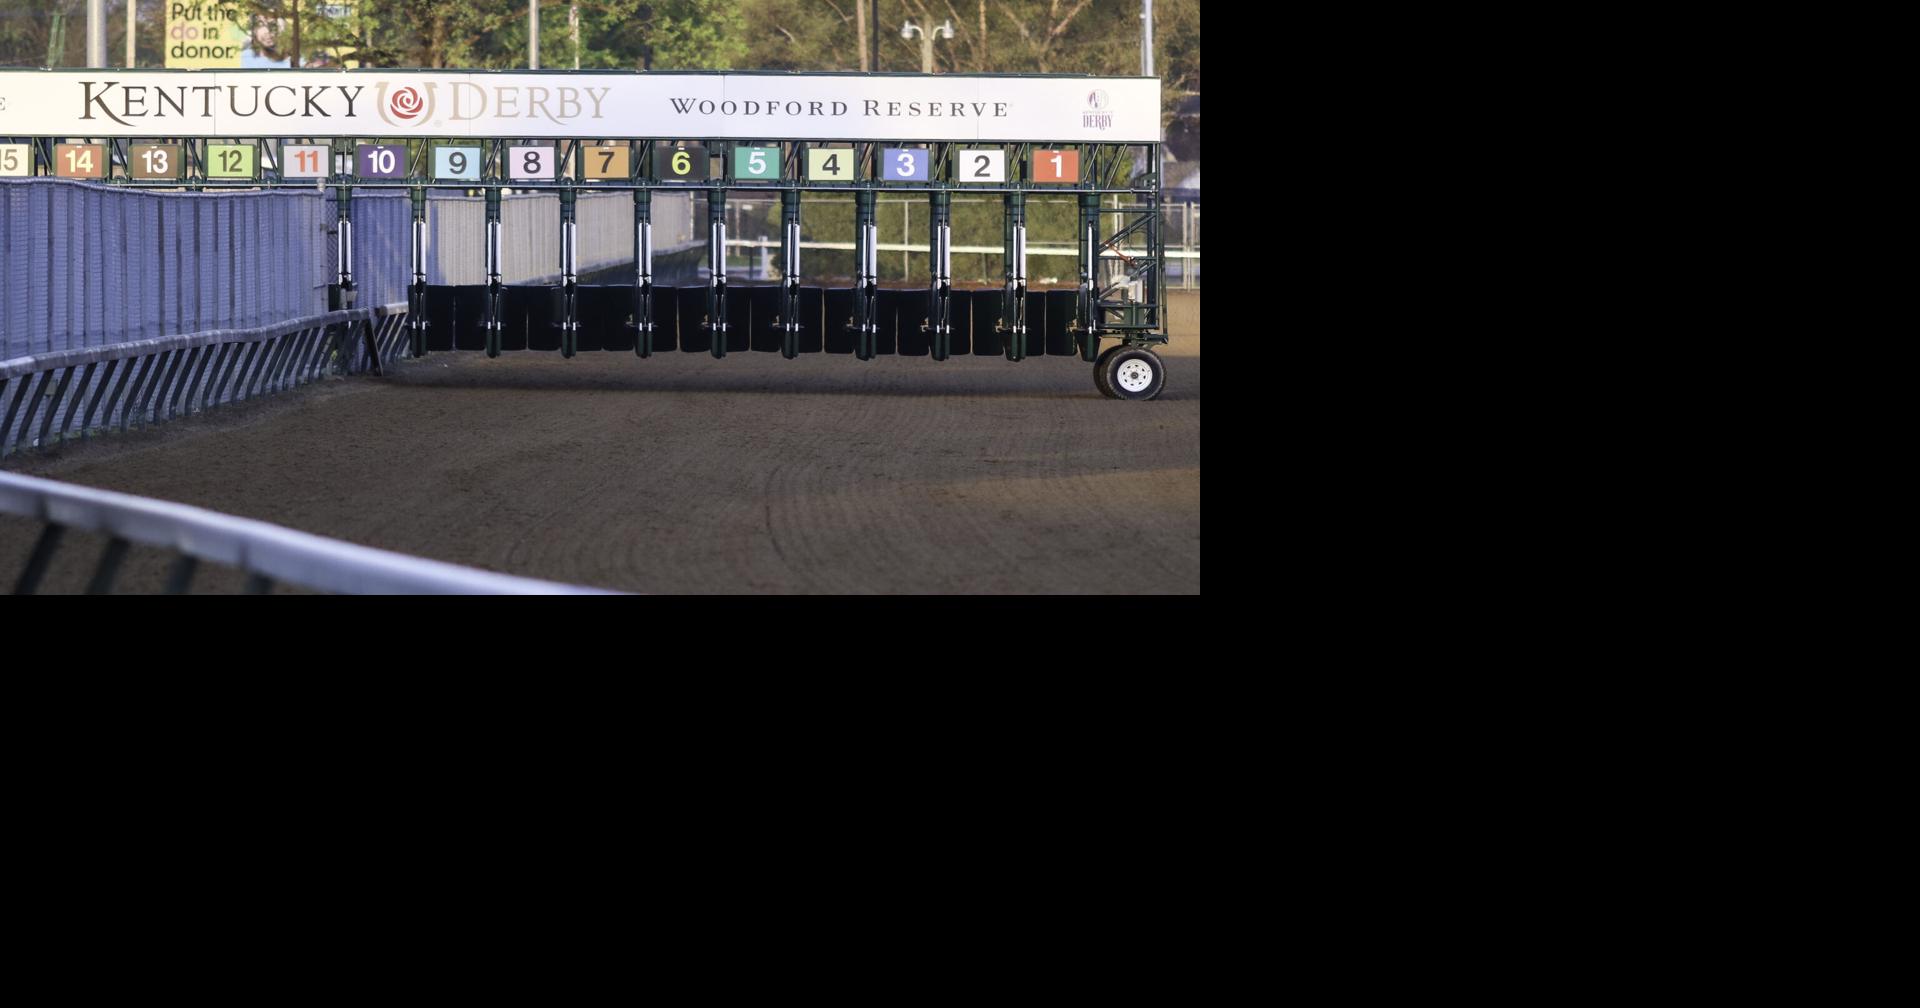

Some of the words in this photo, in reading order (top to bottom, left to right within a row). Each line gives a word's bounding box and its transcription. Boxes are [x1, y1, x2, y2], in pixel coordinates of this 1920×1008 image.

[172, 3, 206, 21] Put
[208, 3, 236, 21] the
[171, 22, 199, 40] do
[203, 23, 220, 39] in
[78, 81, 365, 127] KENTUCKY
[448, 81, 611, 126] DERBY
[670, 97, 848, 116] WOODFORD
[863, 99, 1008, 117] RESERVE
[1082, 114, 1112, 130] DERBY
[0, 148, 18, 171] 5
[65, 150, 94, 173] 14
[142, 150, 169, 173] 13
[218, 150, 243, 173] 12
[295, 150, 319, 173] 11
[367, 150, 396, 173] 10
[448, 151, 468, 174] 9
[523, 151, 542, 174] 8
[597, 151, 615, 174] 7
[671, 151, 691, 175] 6
[748, 151, 768, 175] 5
[822, 153, 841, 176] 4
[896, 151, 916, 177] 3
[973, 154, 992, 178] 2
[1050, 155, 1064, 178] 1
